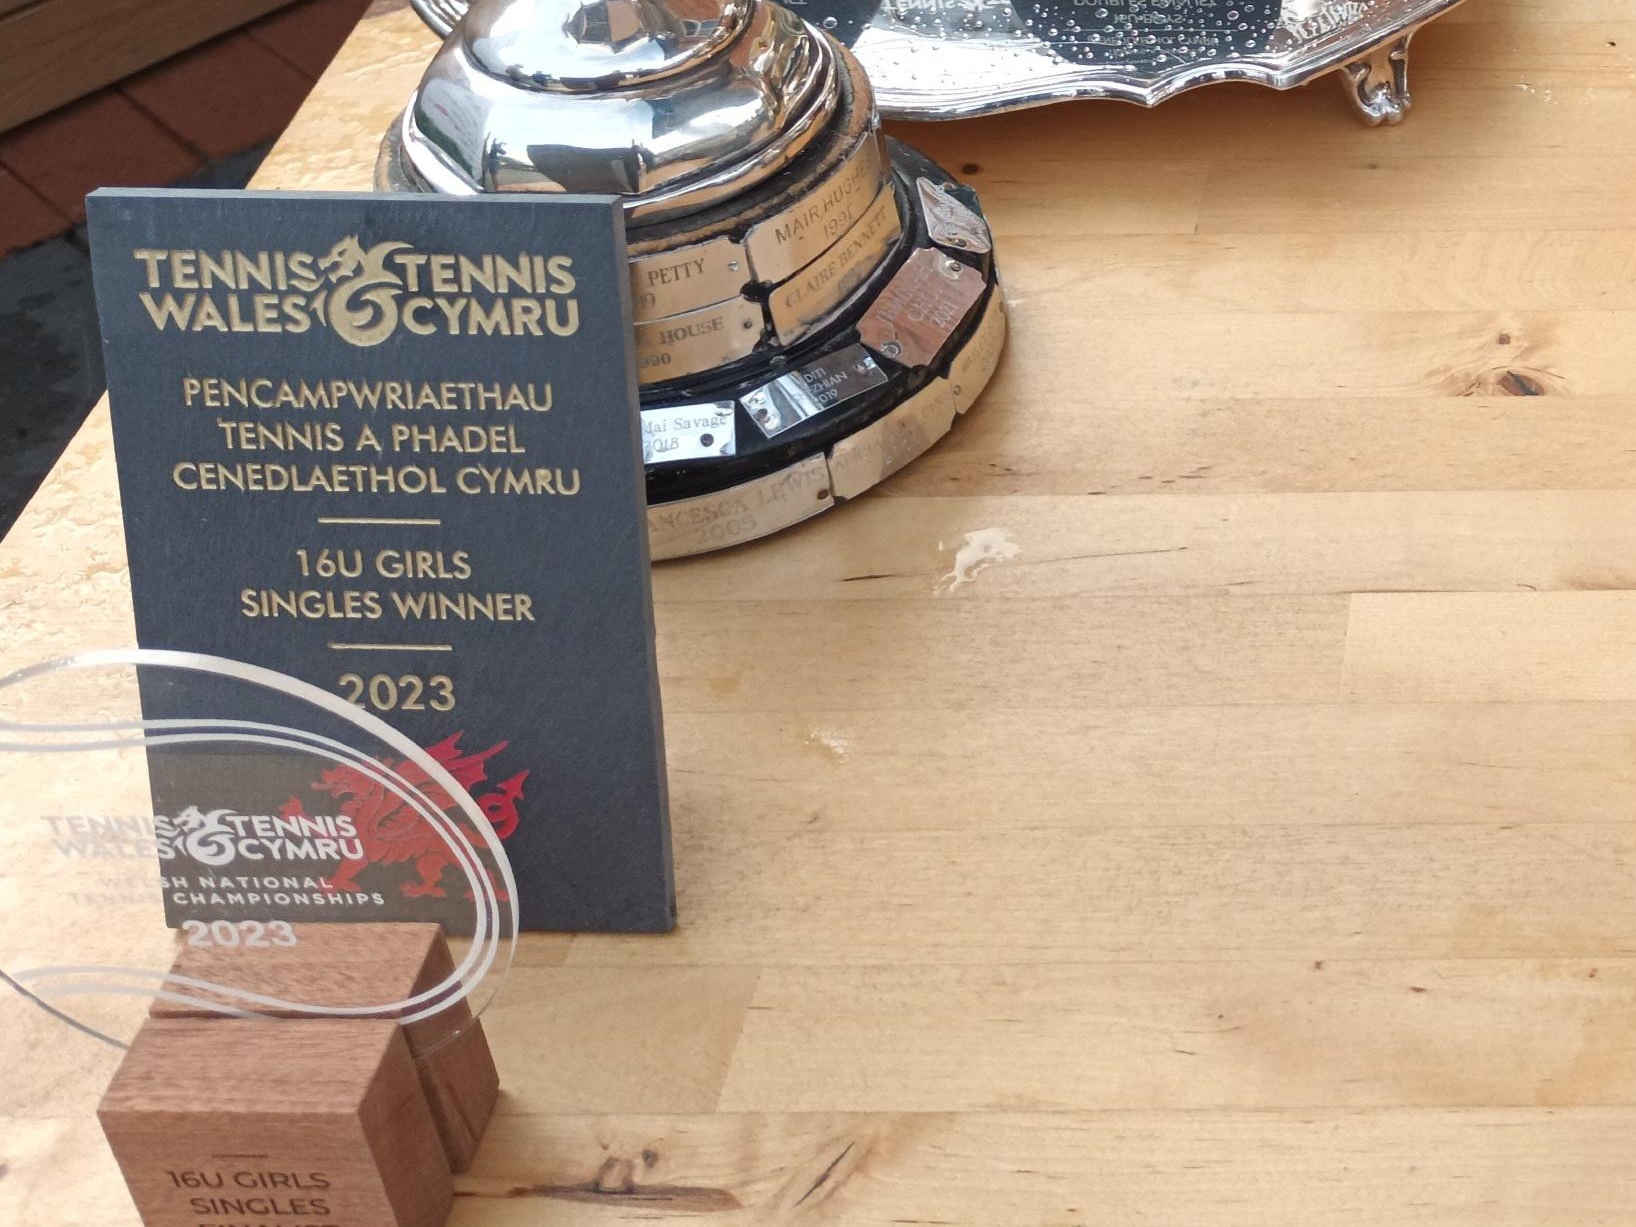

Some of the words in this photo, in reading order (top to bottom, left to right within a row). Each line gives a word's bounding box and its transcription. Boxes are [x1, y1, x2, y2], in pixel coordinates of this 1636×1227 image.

[774, 204, 825, 245] MAIR
[133, 248, 318, 292] TENNIS
[399, 252, 577, 295] TENNIS
[648, 257, 705, 287] PETTY
[785, 261, 837, 308] CLAIRE
[139, 292, 313, 334] WALES
[402, 297, 580, 337] CYMRU
[660, 316, 726, 346] HOUSE
[182, 377, 554, 412] PENCAMPWRIAETHAU
[218, 417, 342, 453] TENNIS
[392, 421, 526, 455] PHADEL
[673, 412, 727, 431] Savage
[173, 461, 447, 495] CENEDLAETHOL
[457, 466, 582, 496] CYMRU
[757, 465, 826, 505] LEWIS
[694, 514, 758, 546] 2005
[296, 548, 363, 579] 16U
[376, 549, 472, 581] GIRLS
[241, 589, 382, 620] SINGLES
[392, 592, 535, 623] WINNER
[338, 673, 457, 712] 2023
[229, 814, 358, 838] TENNIS
[237, 837, 364, 861] CYMRU
[173, 892, 385, 906] CHAMPIONSHIPS
[199, 876, 334, 890] NATIONAL
[182, 920, 298, 949] 2023
[166, 1171, 224, 1190] 16U
[233, 1171, 331, 1190] GIRLS
[190, 1197, 331, 1216] SINGLES
